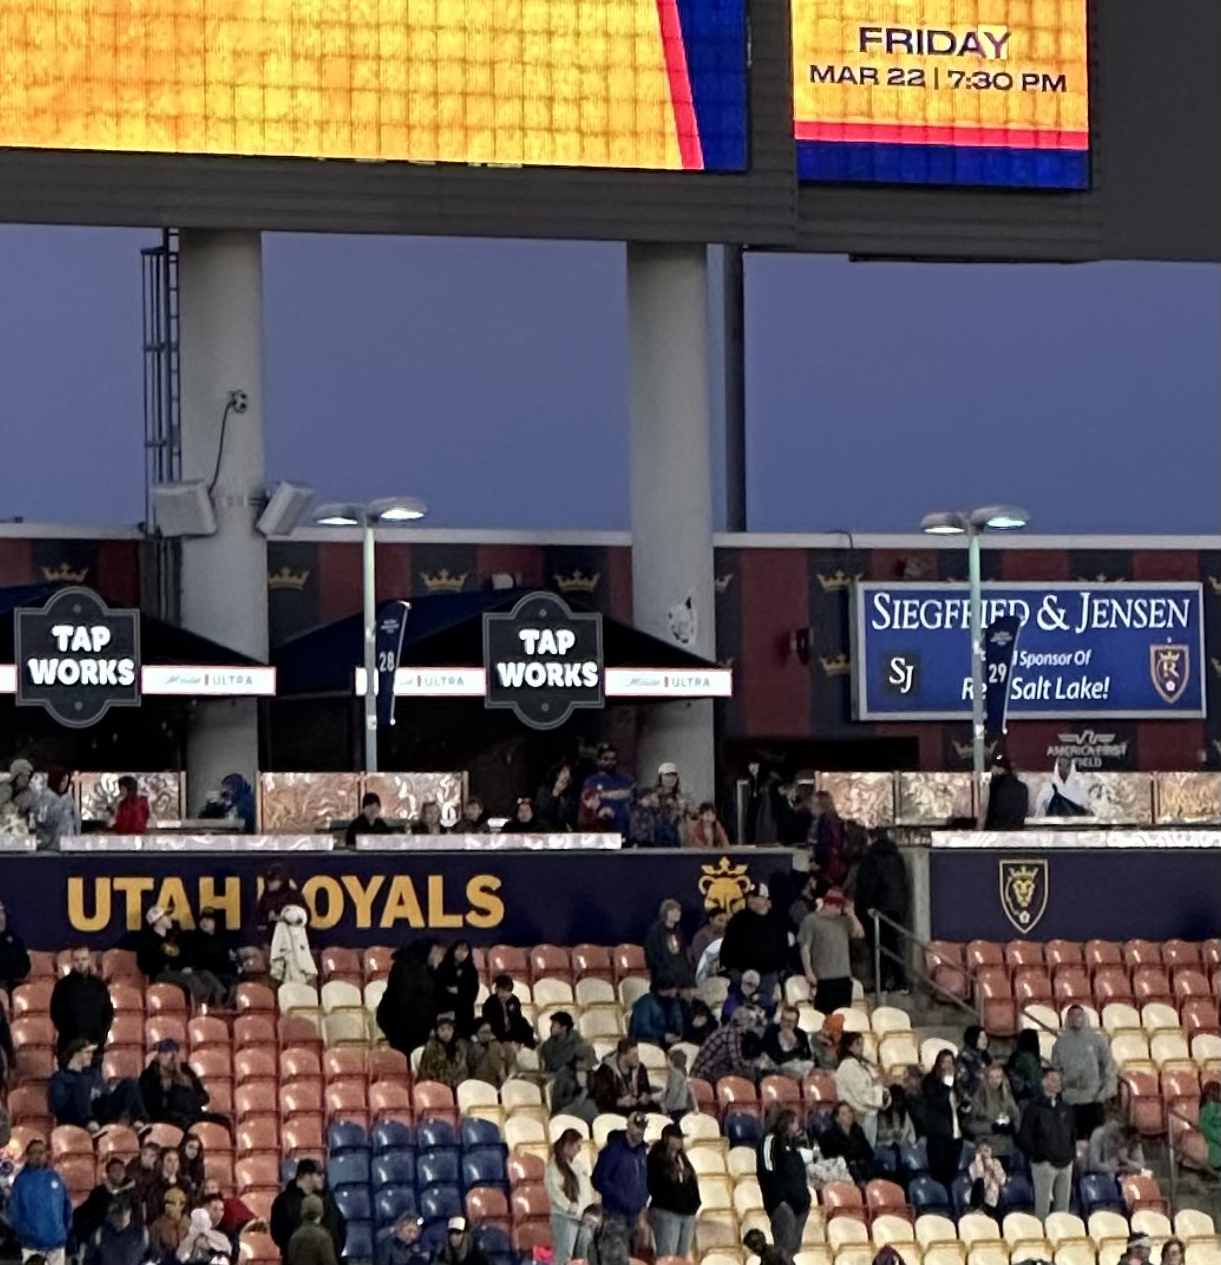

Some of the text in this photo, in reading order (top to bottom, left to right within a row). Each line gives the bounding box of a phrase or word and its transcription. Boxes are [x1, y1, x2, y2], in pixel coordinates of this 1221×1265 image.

[859, 26, 1011, 59] FRIDAY
[809, 64, 879, 87] MAR
[887, 67, 927, 88] 22
[947, 70, 1013, 92] 7:30
[1021, 72, 1067, 94] PM
[1075, 592, 1190, 634] JENSEN
[50, 625, 112, 653] TAP
[518, 628, 576, 656] TAP
[27, 657, 135, 687] WORKS
[379, 651, 395, 672] 28
[1019, 649, 1073, 668] Sponsor
[1075, 649, 1091, 666] Of
[497, 661, 599, 689] WORKS
[988, 663, 1007, 684] 29
[1011, 675, 1050, 700] Salt
[1055, 676, 1110, 700] Lake!
[67, 875, 505, 931] UTAH OYALS
